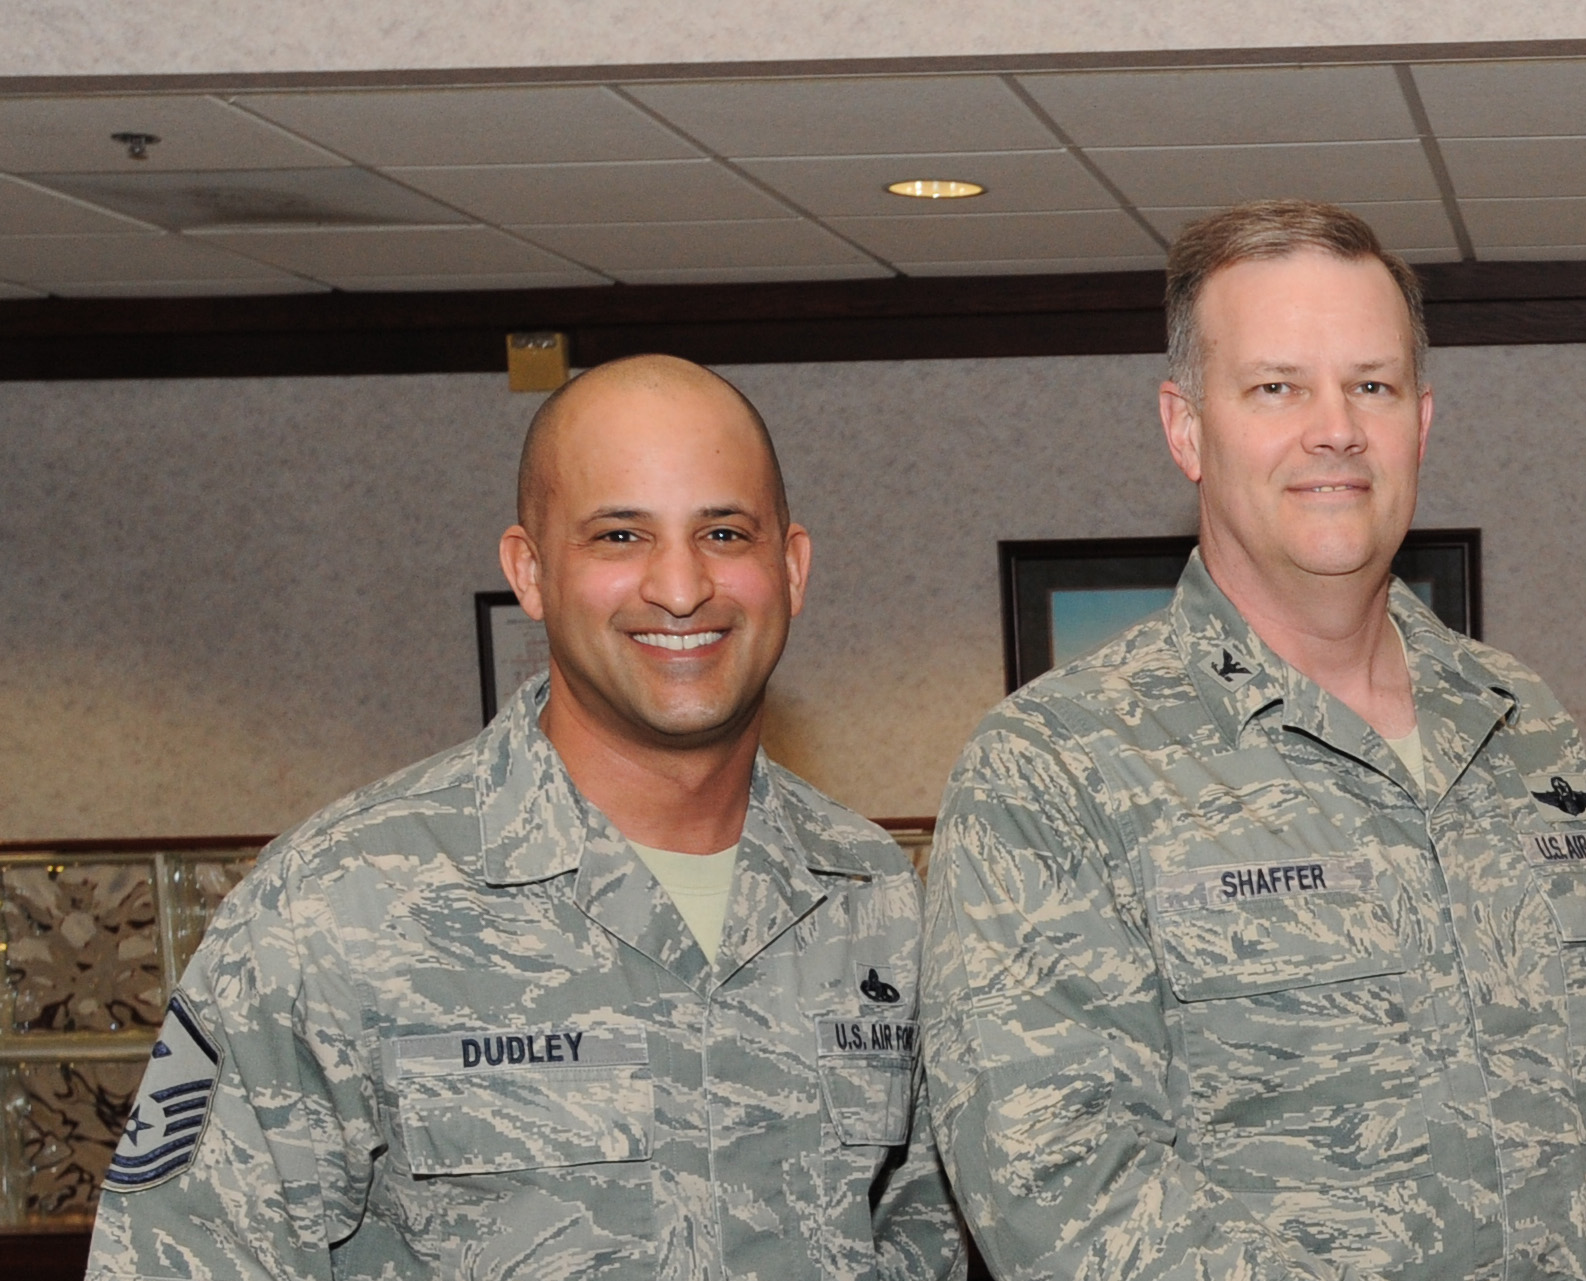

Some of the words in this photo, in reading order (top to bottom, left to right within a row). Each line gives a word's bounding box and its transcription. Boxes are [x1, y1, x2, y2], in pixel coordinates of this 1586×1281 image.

[1534, 835, 1568, 860] U.S.
[1221, 864, 1327, 897] SHAFFER
[461, 1032, 583, 1068] DUDLEY
[835, 1023, 867, 1050] U.S.
[872, 1023, 893, 1050] AIR
